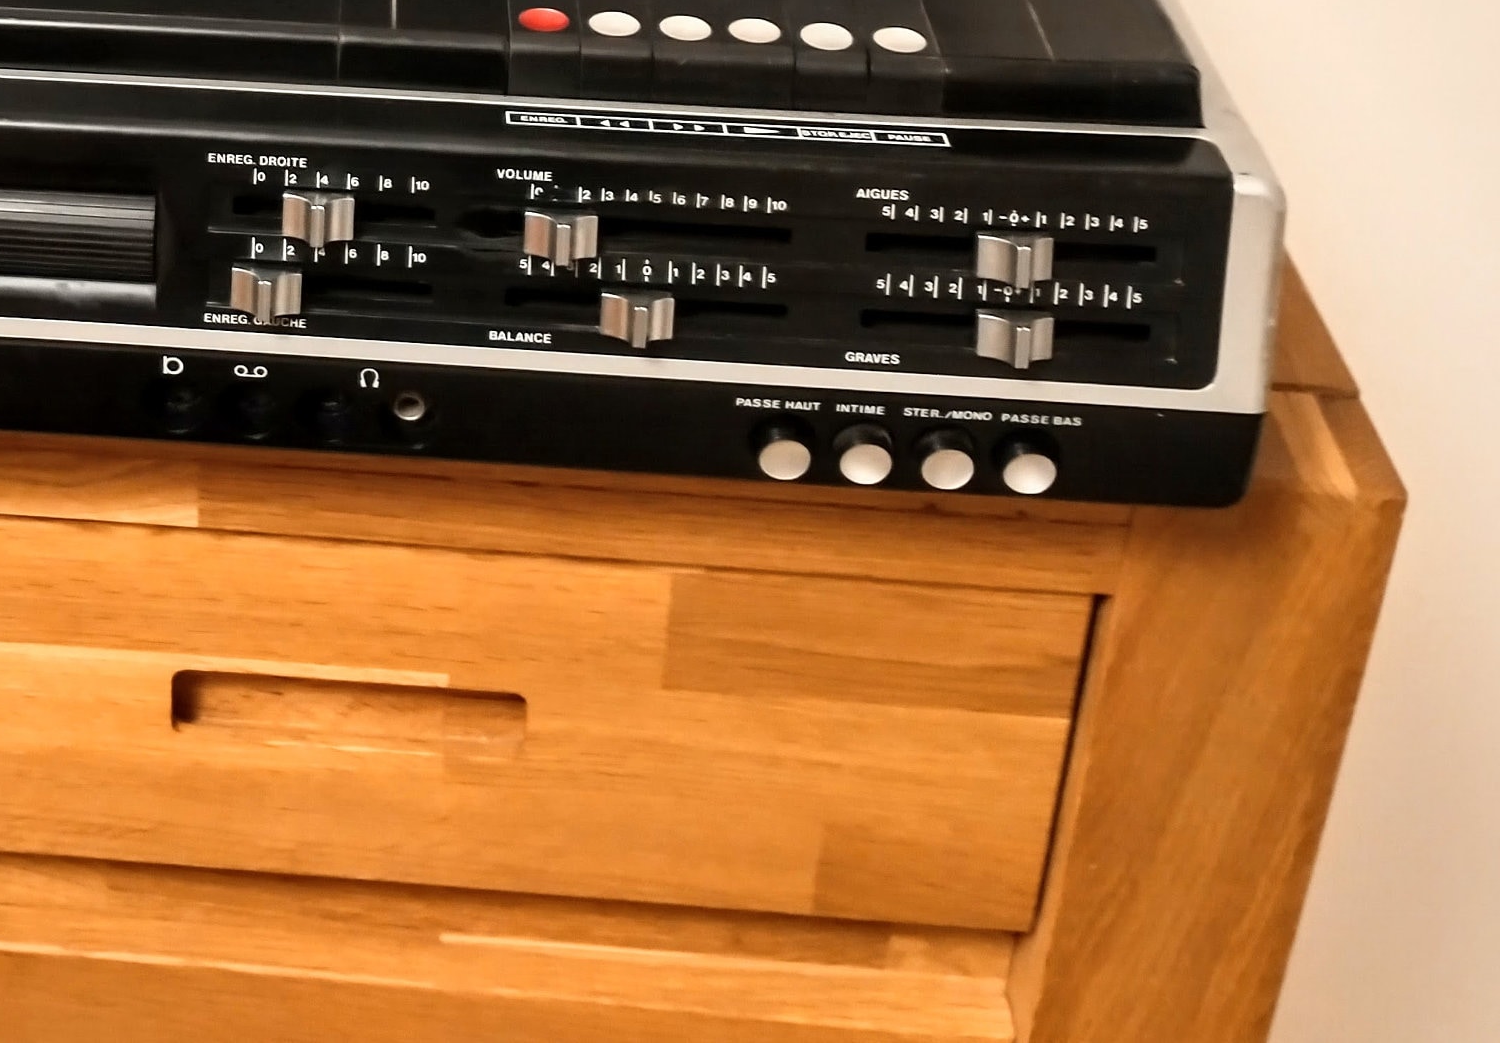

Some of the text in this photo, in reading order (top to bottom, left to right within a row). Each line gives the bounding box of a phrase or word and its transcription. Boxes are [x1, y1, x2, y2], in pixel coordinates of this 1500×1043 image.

[887, 133, 932, 143] PAUSE
[207, 152, 309, 169] ENREG. DROITE
[257, 171, 430, 191] 0 2 4 6 8 10
[496, 168, 553, 182] VOLUME
[582, 189, 787, 211] 2 3 4 5 6 7 8 9 10
[856, 188, 910, 201] AIGUES
[882, 206, 891, 217] 5
[905, 208, 914, 218] 4
[930, 209, 939, 219] 3
[954, 210, 964, 221] 2
[1065, 215, 1075, 226] 2
[1090, 217, 1100, 227] 3
[1114, 218, 1124, 228] 4
[1139, 219, 1149, 230] 5
[255, 243, 427, 263] 0 2 6 8 10
[519, 259, 528, 270] 5
[589, 263, 598, 273] 2
[696, 269, 705, 279] 2
[721, 270, 730, 281] 3
[742, 271, 752, 282] 4
[767, 273, 777, 284] 5
[876, 279, 886, 289] 5
[899, 280, 909, 290] 4
[924, 281, 933, 292] 3
[949, 283, 958, 293] 2
[1059, 289, 1068, 299] 2
[1084, 290, 1094, 300] 3
[1108, 291, 1118, 302] 4
[1132, 292, 1142, 303] 5
[203, 313, 251, 326] ENREG.
[488, 330, 552, 344] BALANCE
[845, 352, 900, 365] GRAVES
[735, 397, 822, 412] PASSE HAUT
[835, 403, 886, 416] INTIME
[1000, 413, 1083, 428] PASSE BAS
